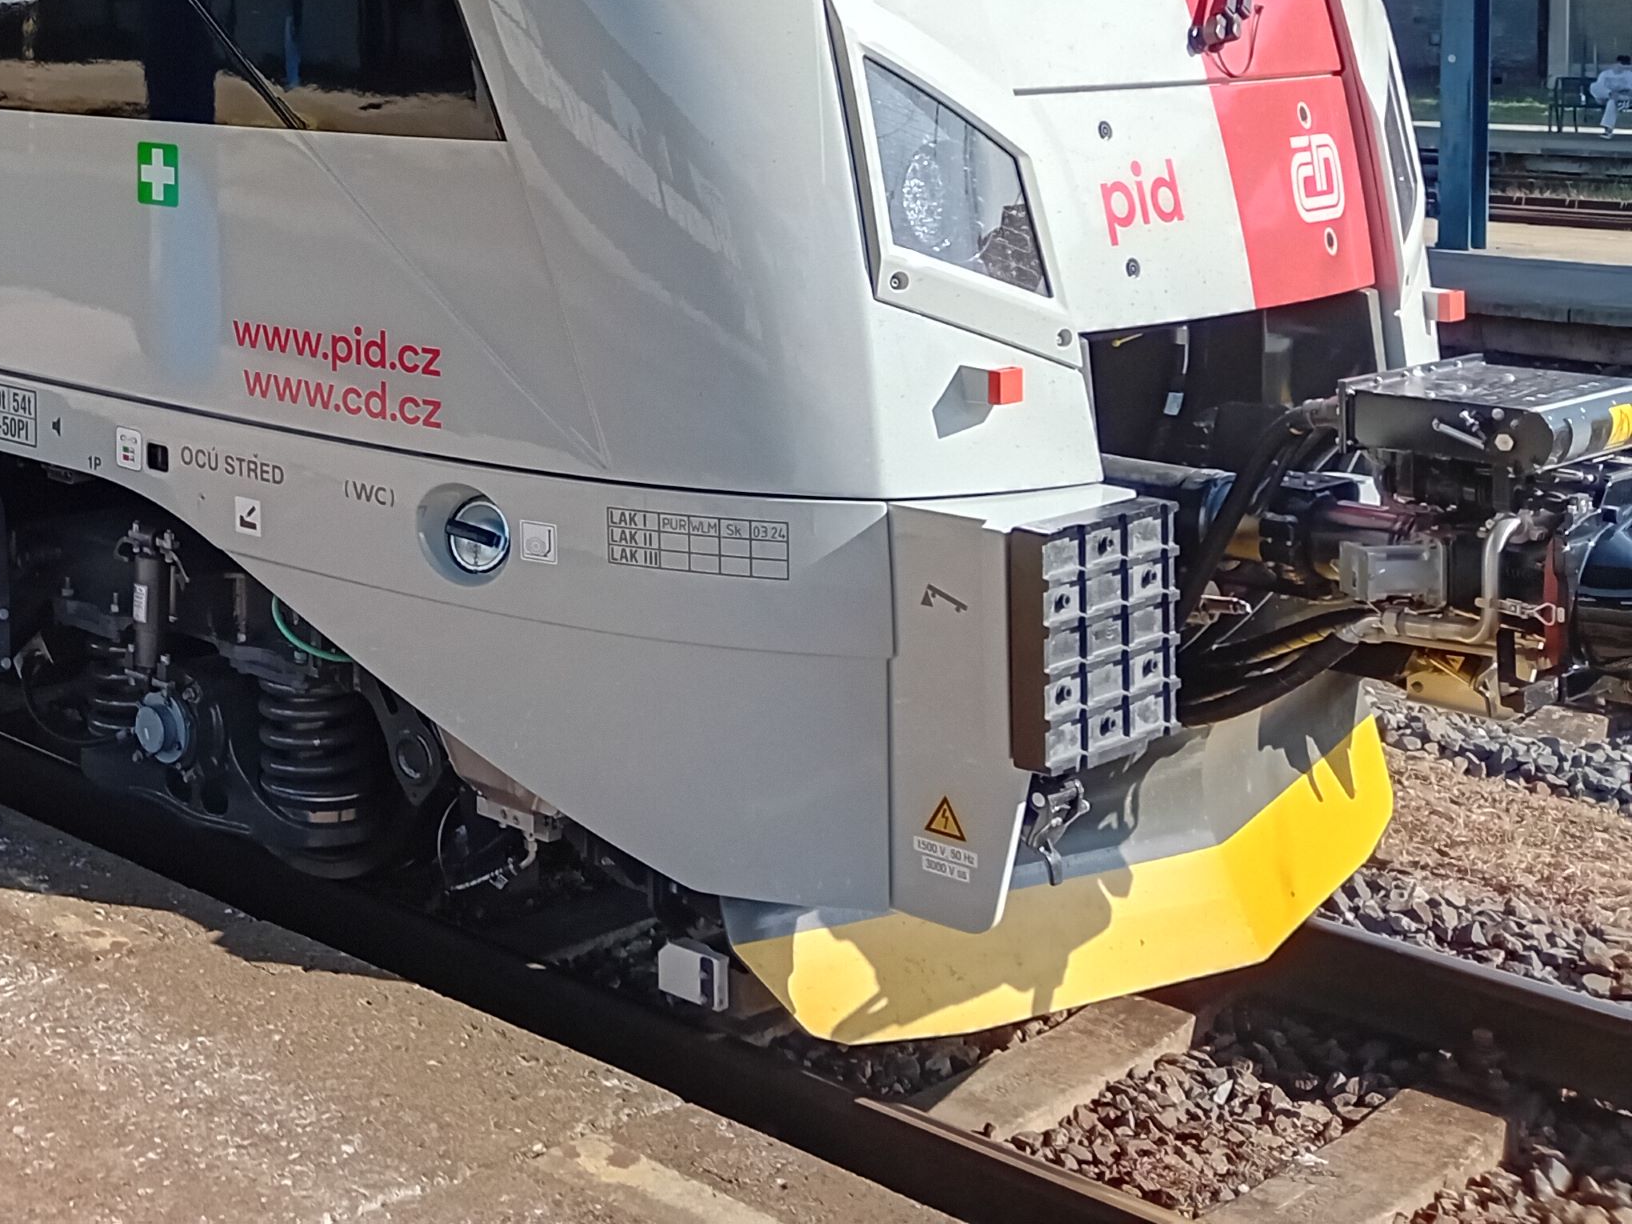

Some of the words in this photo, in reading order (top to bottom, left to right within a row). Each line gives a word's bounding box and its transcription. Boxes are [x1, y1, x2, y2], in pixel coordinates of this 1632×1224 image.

[1099, 158, 1185, 247] pid
[233, 320, 441, 377] www.pid.cz
[12, 392, 32, 416] 54t
[243, 369, 442, 430] www.cd.cz
[87, 456, 102, 470] 1P
[180, 446, 219, 472] OCÚ
[224, 452, 285, 486] STŘED
[344, 480, 395, 507] (WC)
[610, 511, 638, 527] LAK
[662, 517, 688, 533] PUR
[689, 521, 718, 535] WLM
[610, 529, 639, 546] LAK
[643, 532, 653, 547] II
[726, 524, 742, 538] Sk
[610, 547, 639, 564] LAK
[644, 549, 658, 566] III
[939, 845, 946, 857] V
[948, 865, 955, 876] V
